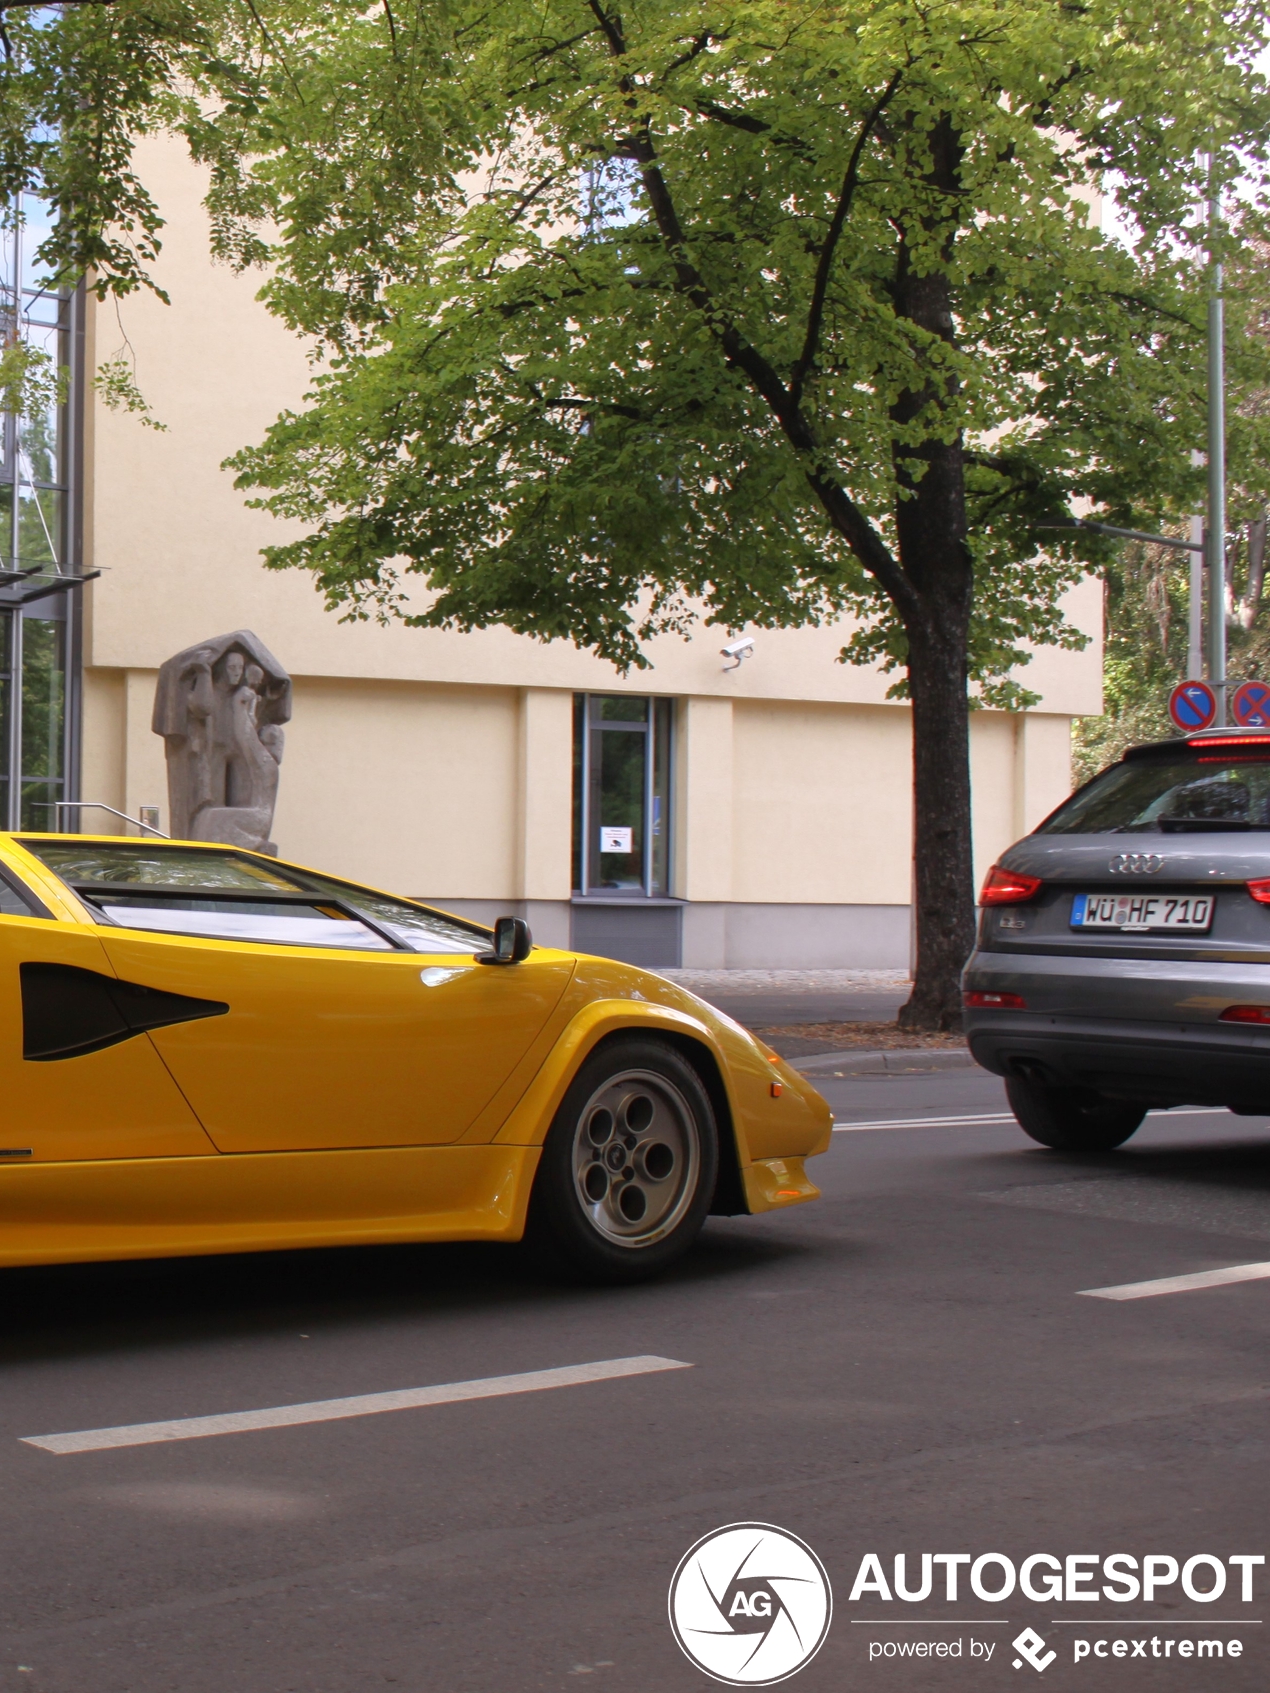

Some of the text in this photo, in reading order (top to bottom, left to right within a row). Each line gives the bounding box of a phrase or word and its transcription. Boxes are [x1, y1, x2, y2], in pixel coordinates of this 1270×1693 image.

[1086, 898, 1208, 924] WÜ HF 710
